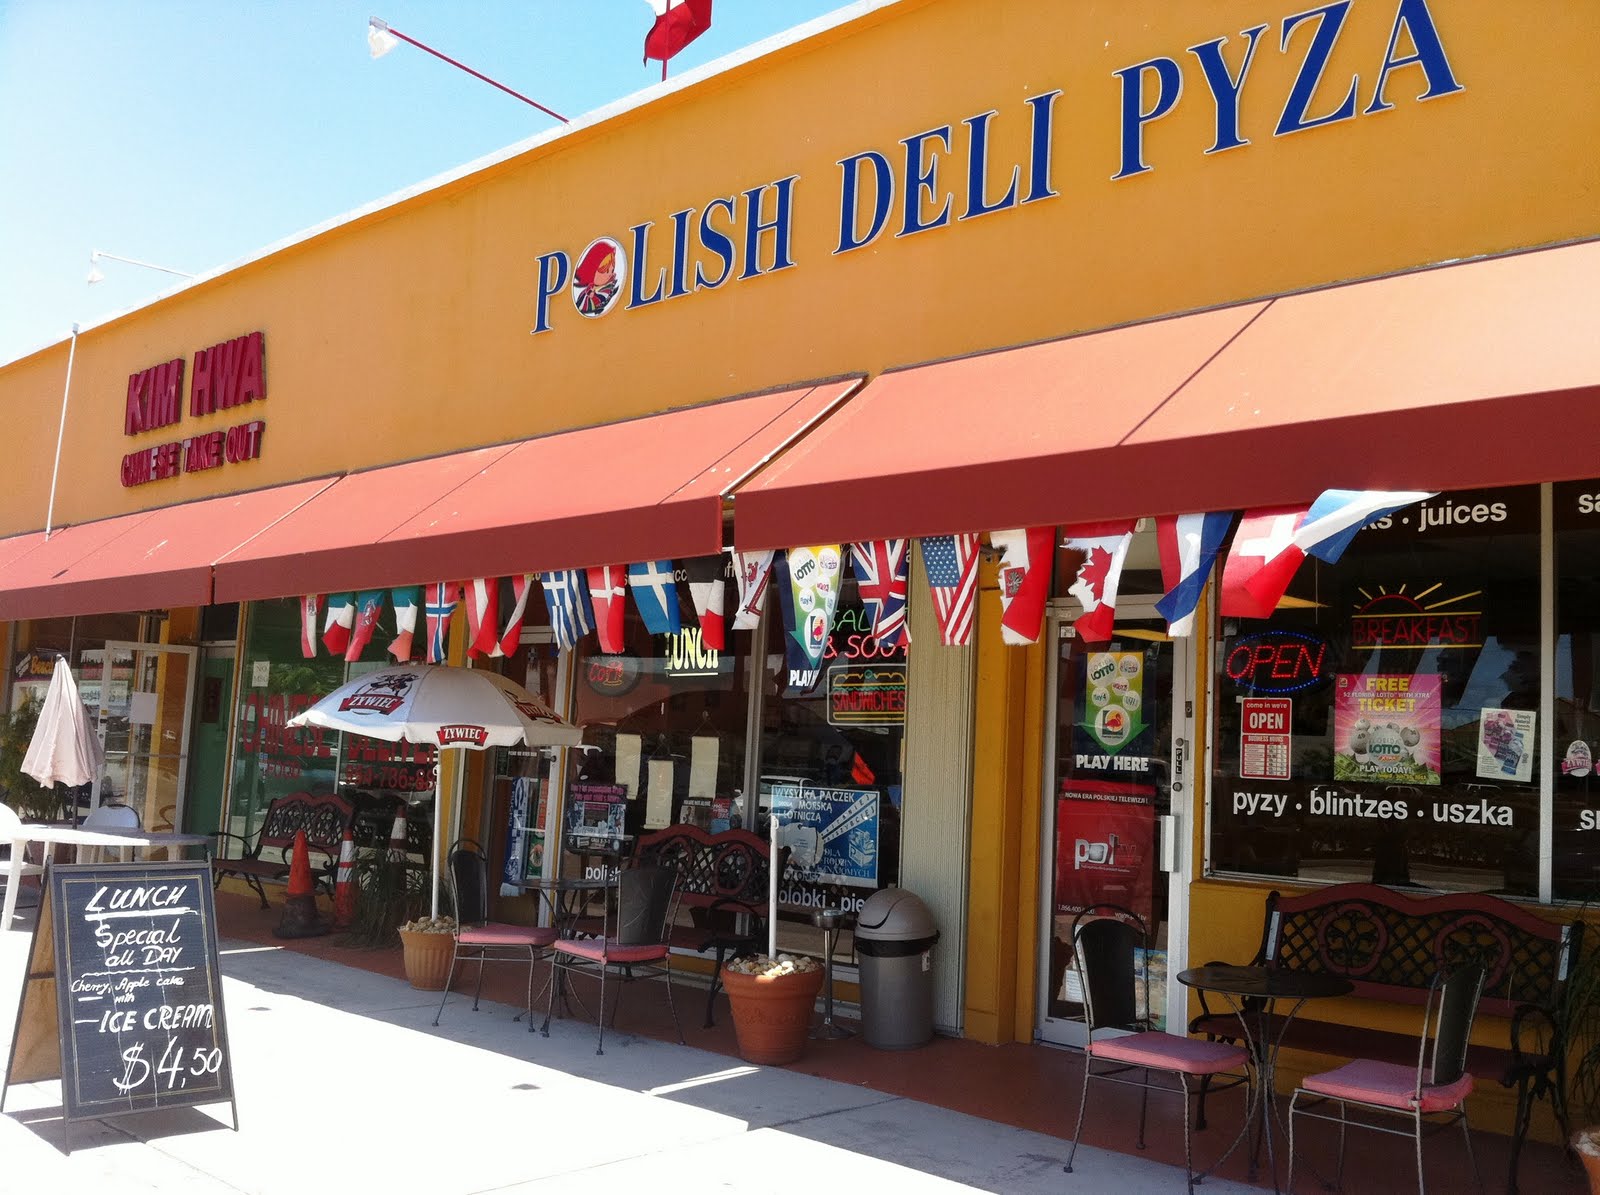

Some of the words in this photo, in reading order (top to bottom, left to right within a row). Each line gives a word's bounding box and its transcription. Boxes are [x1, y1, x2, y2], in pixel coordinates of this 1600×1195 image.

[831, 88, 1064, 257] DELI
[1109, 0, 1466, 182] PYZA
[124, 358, 185, 437] KIM
[190, 331, 267, 417] HWA
[121, 441, 182, 488] CHINESE
[182, 431, 226, 473] TAKE
[225, 420, 265, 464] OUT
[1418, 500, 1507, 532] juices
[793, 558, 816, 581] LOTTO
[1352, 615, 1482, 645] BREAKFAST
[1090, 663, 1115, 681] LOTTO
[1226, 643, 1327, 680] OPEN
[1366, 677, 1410, 692] FREE
[1264, 701, 1271, 709] in
[1358, 698, 1416, 713] TICKET
[1249, 712, 1284, 730] OPEN
[1369, 744, 1401, 755] LOTTO
[1076, 754, 1111, 770] PLAY
[1113, 755, 1149, 772] HERE
[1359, 765, 1379, 773] PLAY
[1382, 765, 1412, 774] TODAY!
[819, 790, 856, 803] PACZEK
[798, 801, 833, 814] MORSKĄ
[1233, 791, 1288, 818] pyzy
[1309, 789, 1409, 820] blintzes
[1433, 799, 1513, 826] uszka
[85, 885, 187, 911] LUNCH
[95, 918, 181, 948] Special
[105, 953, 135, 967] all
[142, 946, 184, 966] DAY
[115, 976, 151, 993] Apple
[156, 976, 185, 987] cake
[98, 1010, 137, 1034] ICE
[143, 1003, 214, 1031] CREAM
